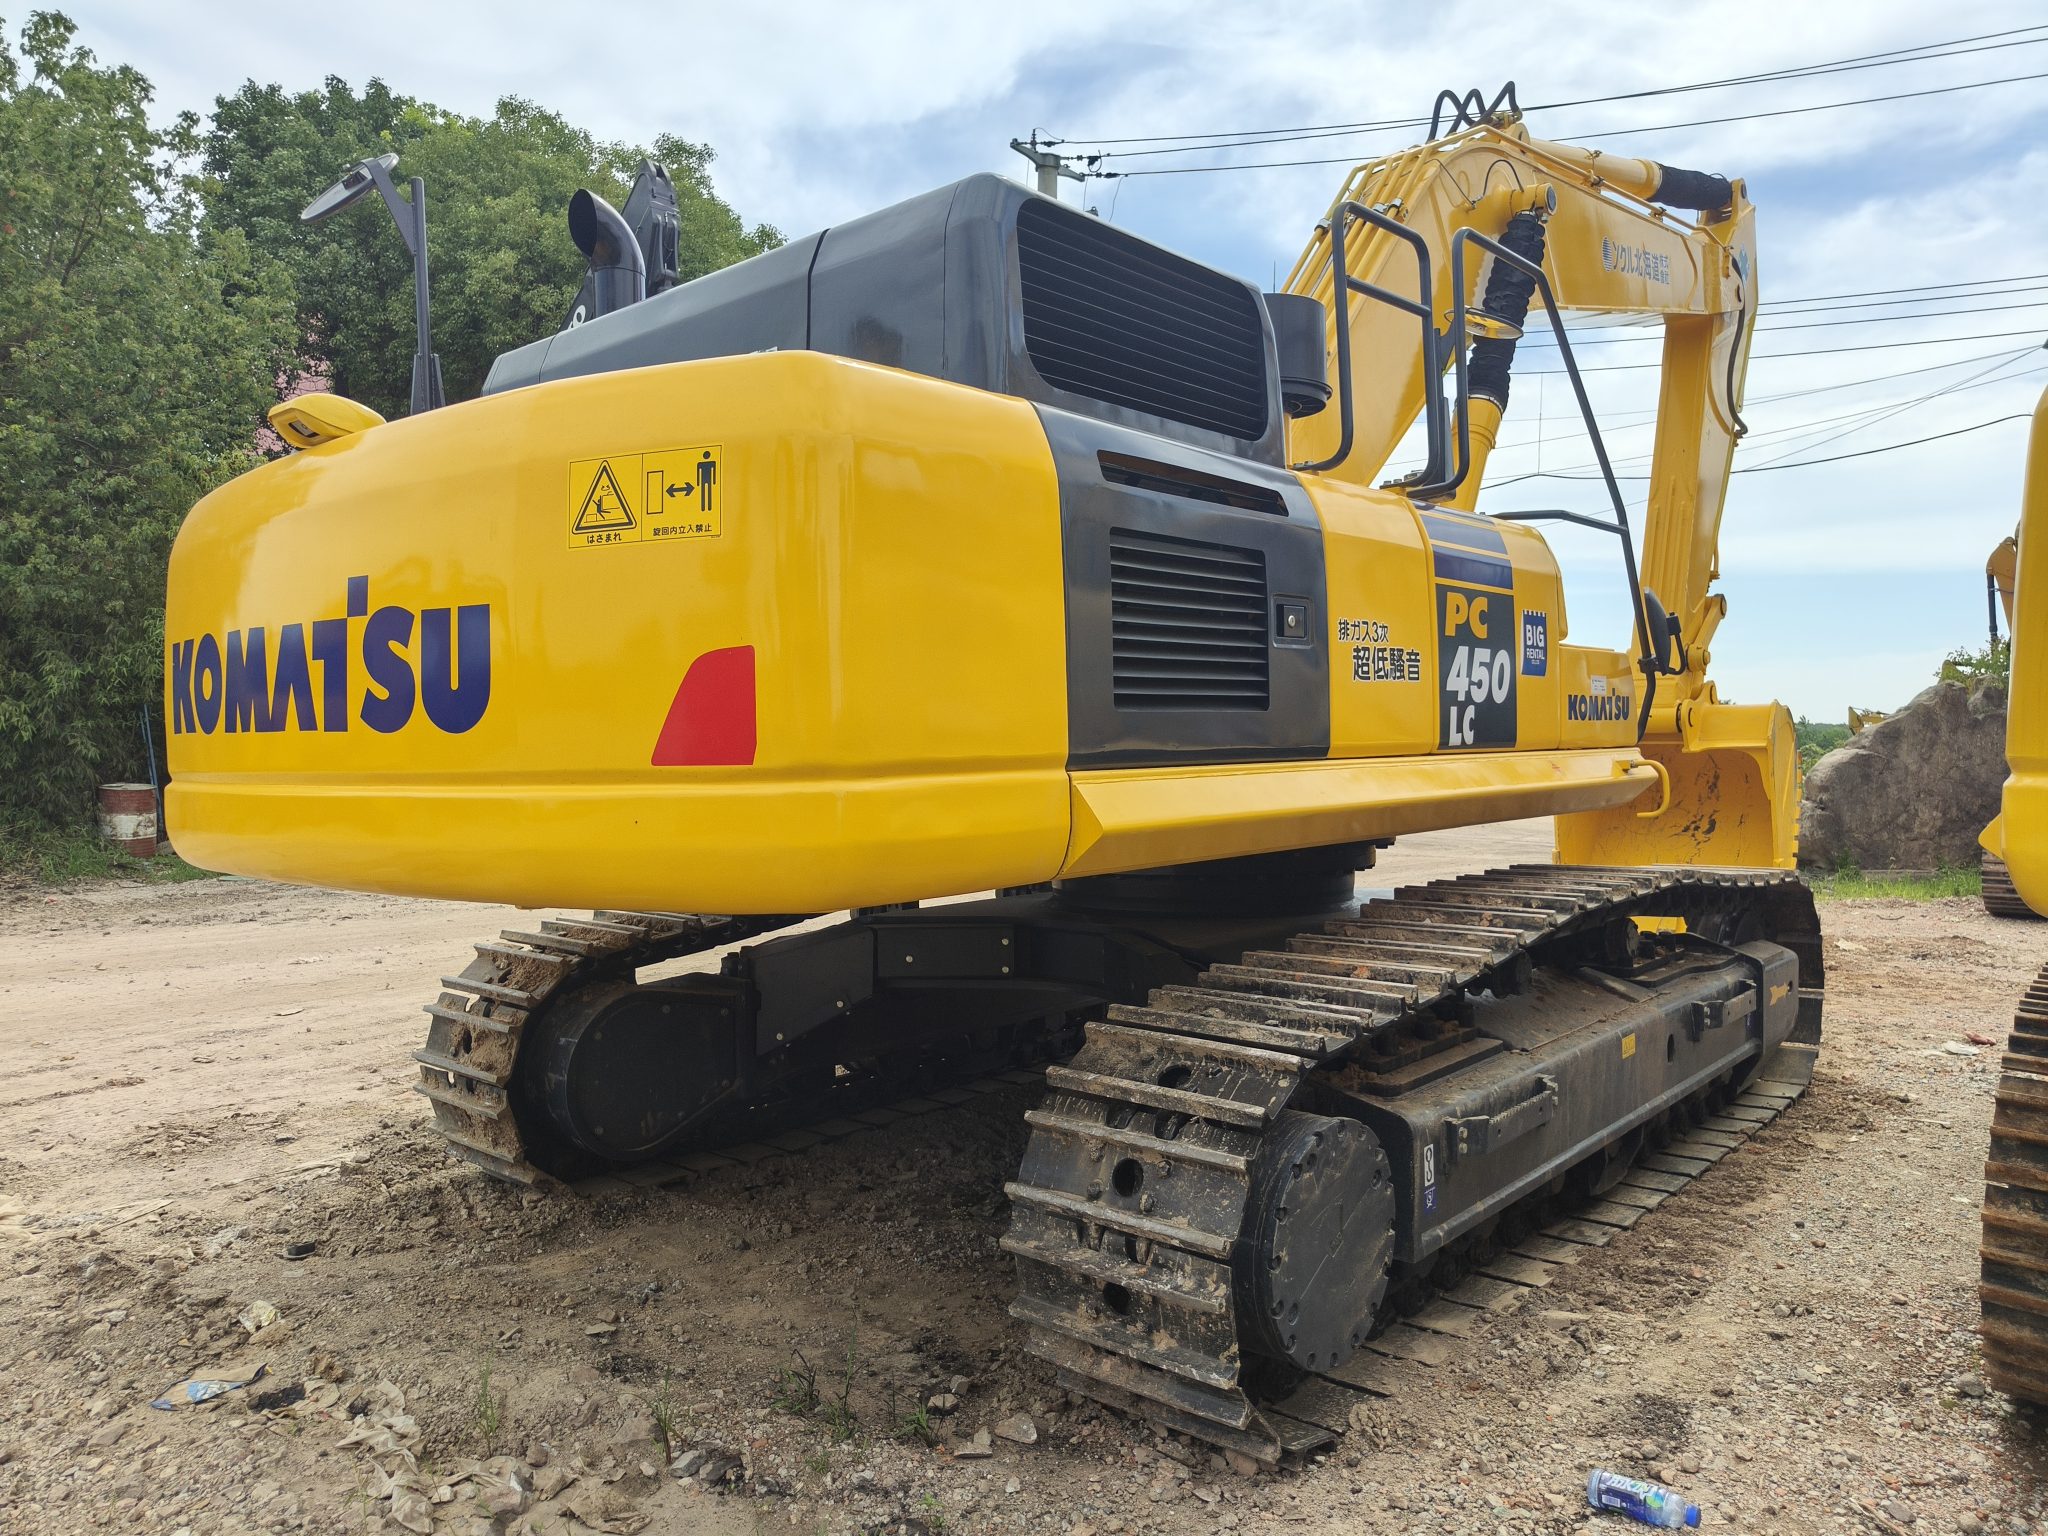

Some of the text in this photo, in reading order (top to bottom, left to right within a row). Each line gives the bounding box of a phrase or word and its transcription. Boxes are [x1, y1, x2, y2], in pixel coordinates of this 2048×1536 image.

[586, 532, 622, 544] はさまれ
[653, 523, 712, 537] 旋回内立入禁止
[1338, 618, 1389, 643] 排ガス3次
[1444, 591, 1488, 639] PC
[1525, 624, 1545, 647] BIG
[172, 574, 491, 735] KOMATSU
[1353, 645, 1421, 681] 超低騒音
[1526, 648, 1545, 660] RENTAL
[1446, 645, 1511, 704] 450
[1567, 687, 1630, 721] KOMATSU
[1448, 704, 1476, 747] LC
